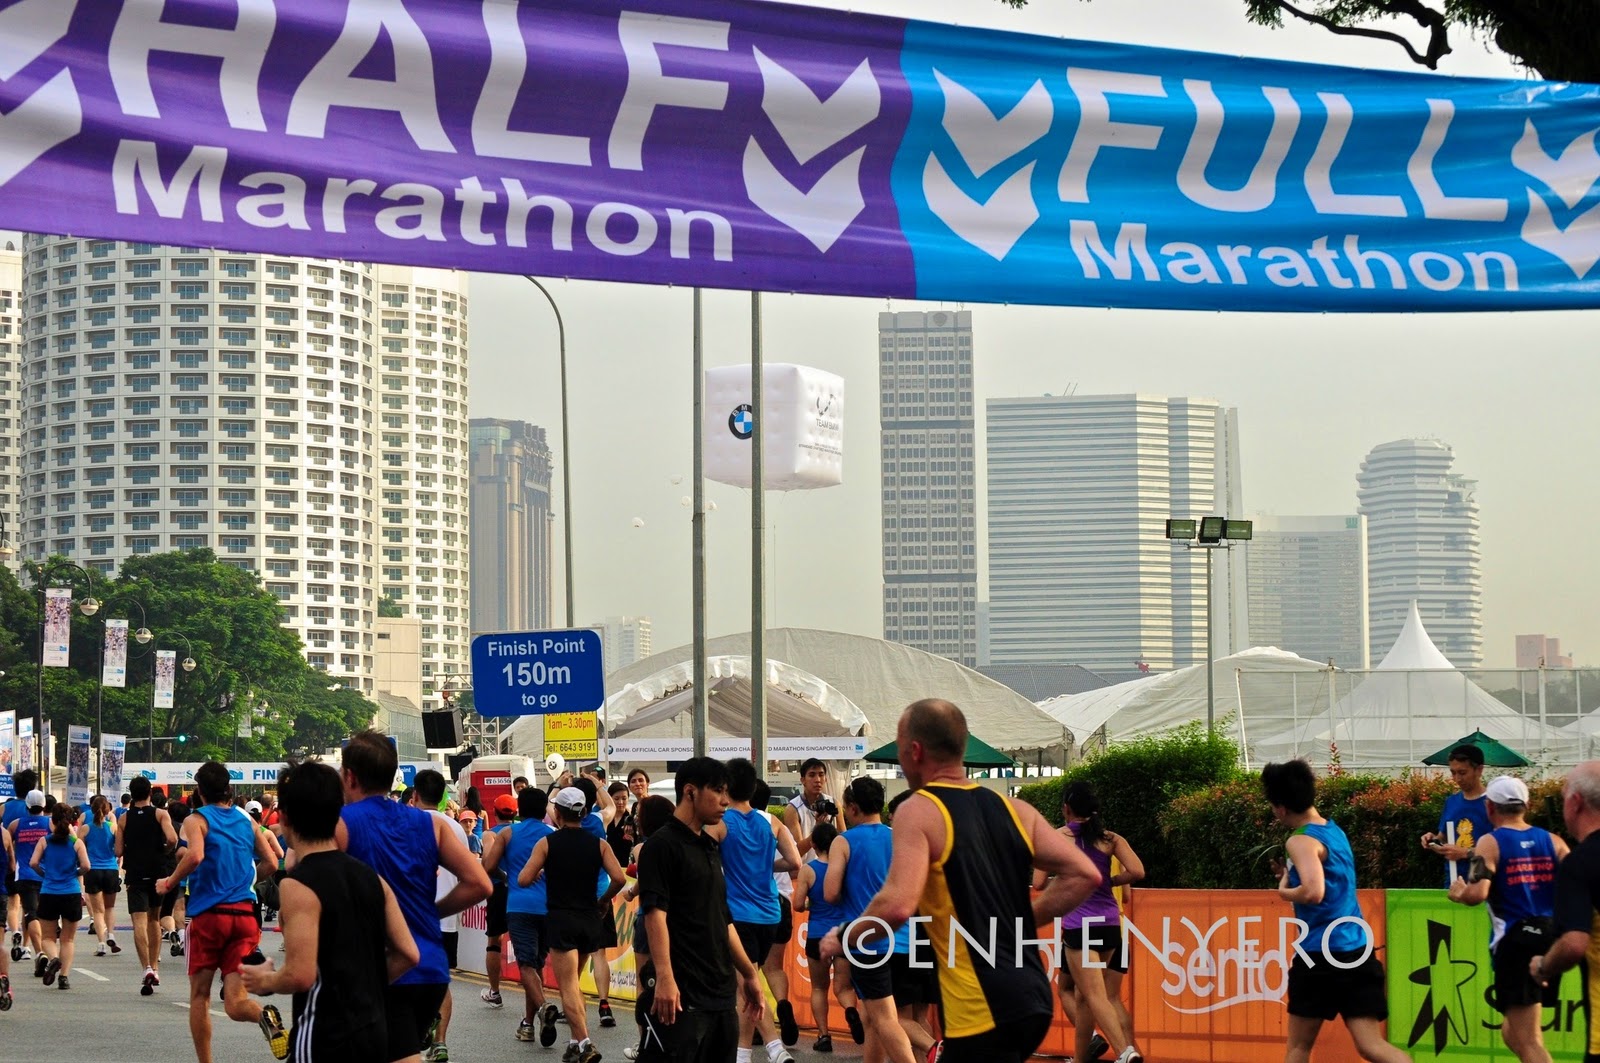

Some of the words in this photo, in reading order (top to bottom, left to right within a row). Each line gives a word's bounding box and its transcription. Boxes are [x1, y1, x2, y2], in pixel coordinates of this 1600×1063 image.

[107, 0, 731, 171] HALF
[1057, 67, 1509, 222] FULL
[112, 139, 733, 262] Marathon
[1069, 220, 1519, 292] Marathon
[487, 639, 538, 656] Finish
[542, 638, 585, 654] Point
[502, 661, 571, 687] 150m
[521, 693, 536, 706] to
[540, 694, 558, 708] go
[545, 743, 558, 752] Tel:
[560, 742, 577, 752] 6643
[578, 742, 595, 751] 9191
[632, 744, 657, 753] OFFICIAL
[658, 744, 670, 753] CAR
[670, 744, 694, 753] SPONSO
[773, 744, 806, 752] MARATHON
[806, 743, 838, 752] SINGAPORE
[253, 769, 277, 780] FIN
[0, 782, 14, 790] 50m
[1506, 863, 1554, 874] MARATHO
[461, 904, 487, 931] anon
[1160, 940, 1290, 998] sento
